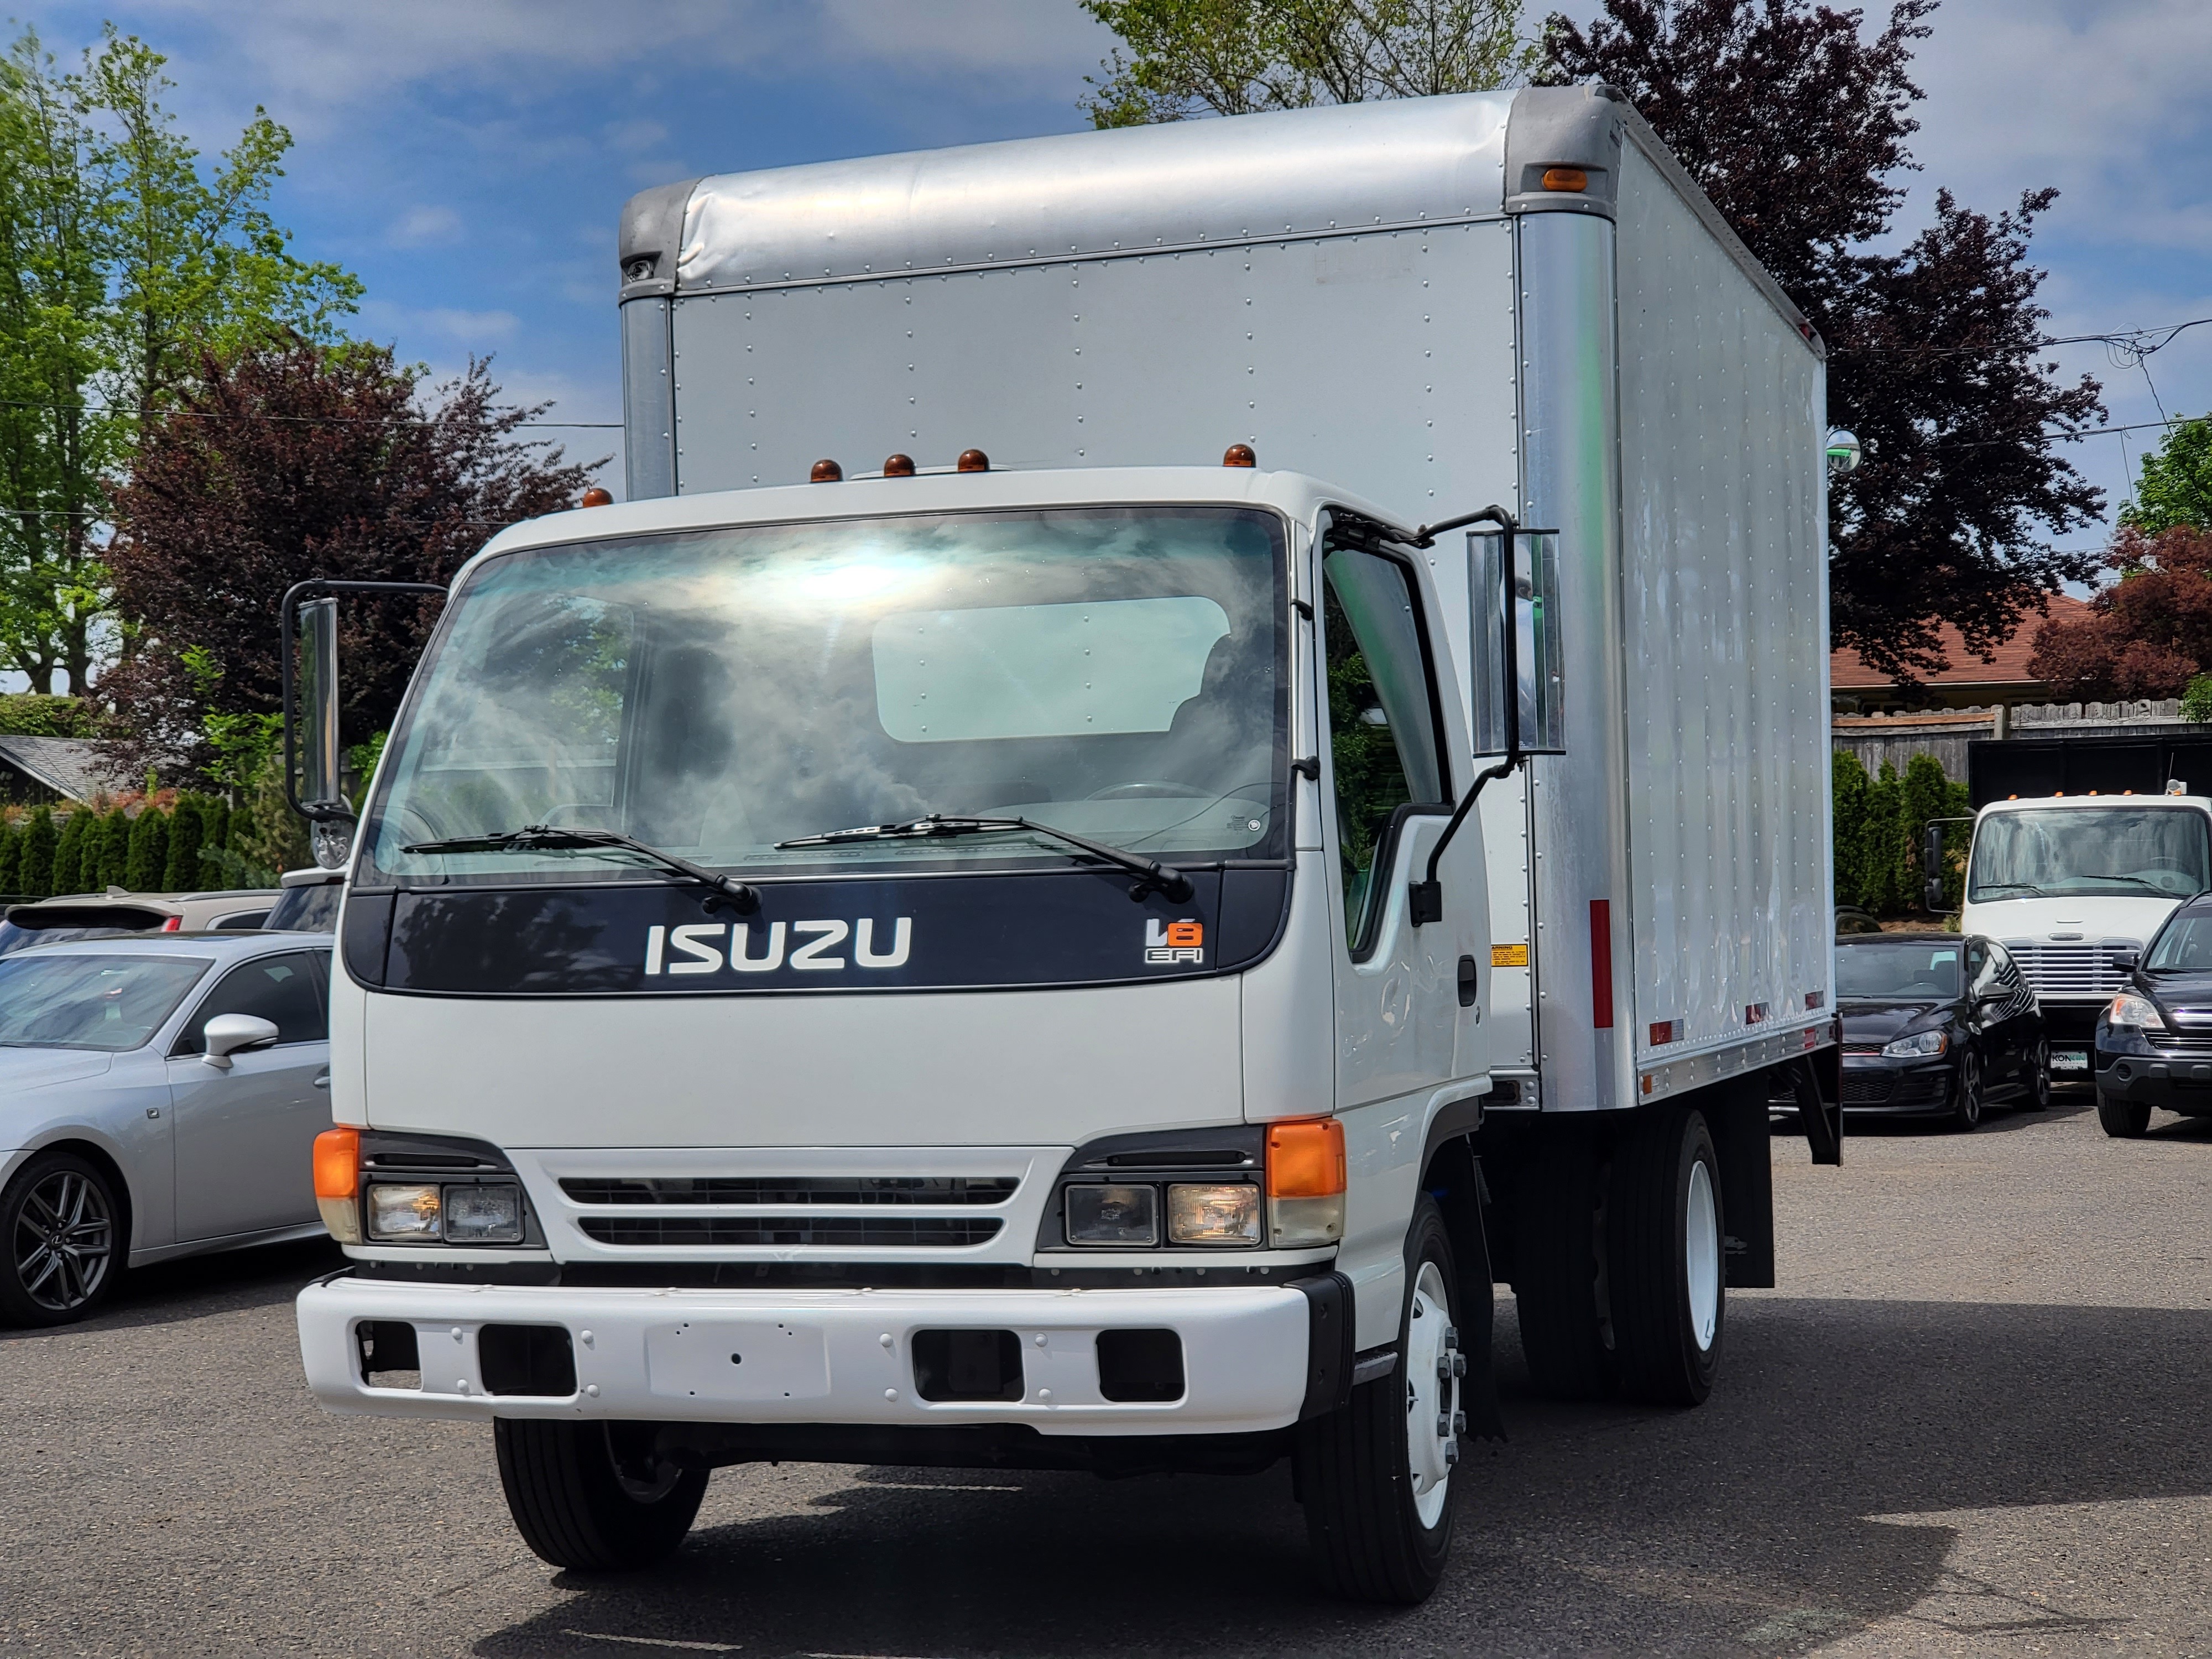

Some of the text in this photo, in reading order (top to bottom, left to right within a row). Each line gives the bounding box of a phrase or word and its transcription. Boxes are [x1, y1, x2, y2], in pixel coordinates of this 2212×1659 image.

[645, 917, 912, 974] ISUZU
[1146, 918, 1203, 946] V8
[1145, 947, 1203, 963] EFI
